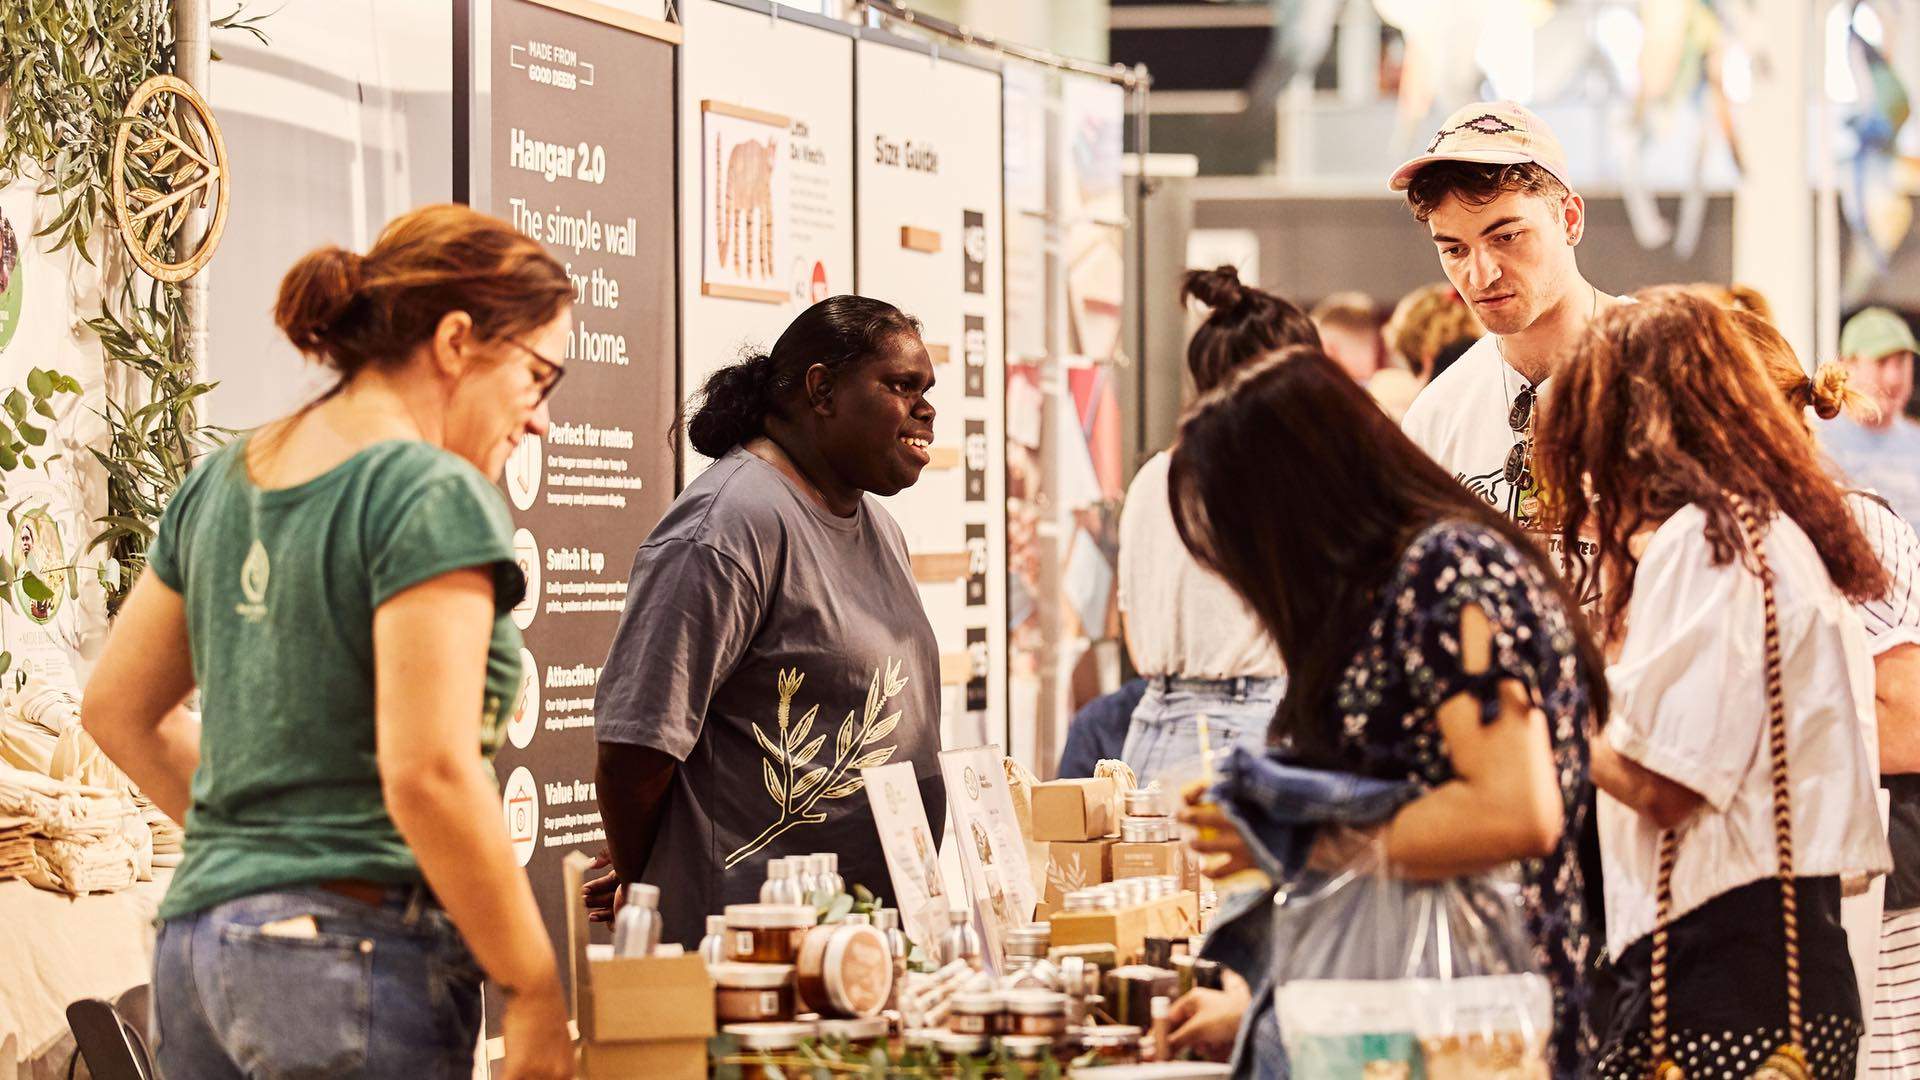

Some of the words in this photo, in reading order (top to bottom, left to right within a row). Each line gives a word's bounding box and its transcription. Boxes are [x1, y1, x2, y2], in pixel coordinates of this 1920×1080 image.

[528, 40, 552, 61] MADE
[553, 46, 577, 67] FROM
[528, 64, 552, 84] GOOD
[552, 69, 577, 90] DEEDS
[510, 127, 575, 182] Hangar
[577, 141, 606, 185] 2.0
[875, 134, 899, 167] Size
[904, 140, 939, 174] Guide
[509, 197, 543, 241] The
[546, 205, 602, 256] simple
[604, 217, 637, 257] wall
[591, 267, 619, 309] the
[580, 320, 630, 366] home.
[548, 421, 584, 446] Perfect
[584, 423, 600, 447] for
[600, 426, 633, 450] renters
[546, 547, 580, 571] Switch
[581, 547, 590, 571] it
[590, 552, 604, 575] up
[545, 663, 595, 688] Attractive
[544, 781, 573, 806] Value
[573, 778, 589, 802] for
